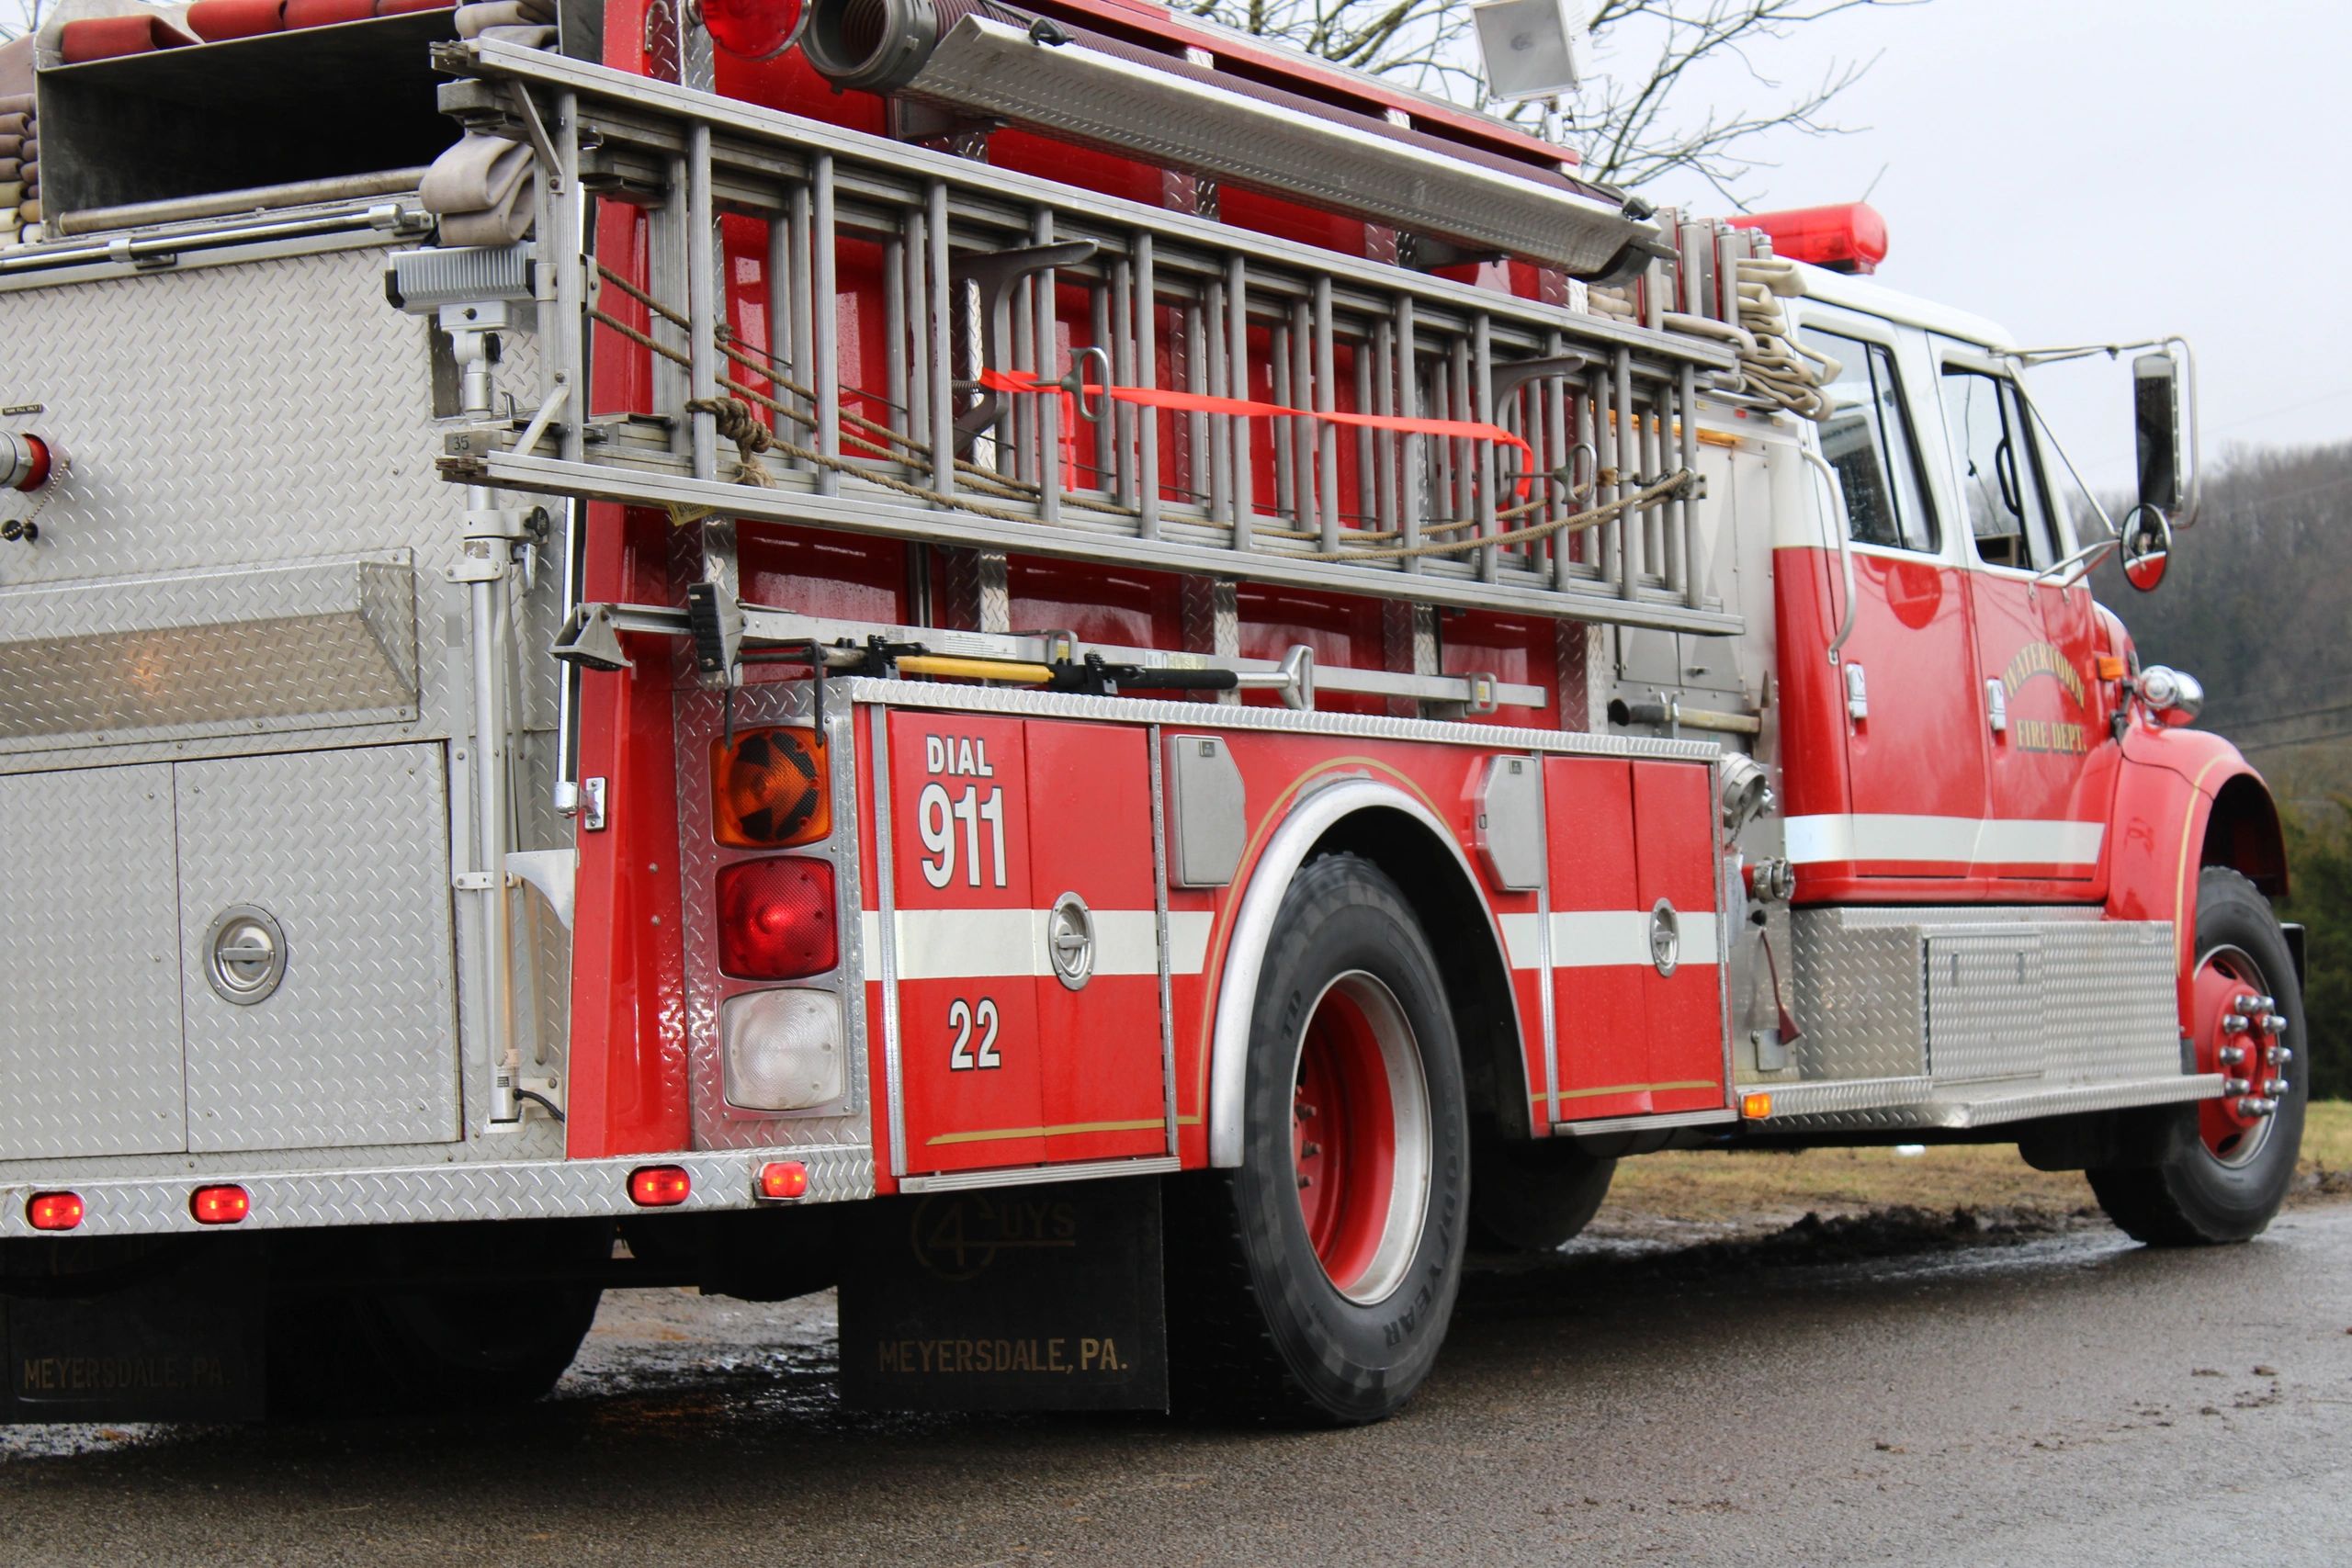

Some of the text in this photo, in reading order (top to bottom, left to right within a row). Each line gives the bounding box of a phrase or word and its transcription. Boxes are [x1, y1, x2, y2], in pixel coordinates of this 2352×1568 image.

[453, 434, 469, 450] 35
[2002, 642, 2085, 711] WATERTOWN
[926, 734, 993, 778] DIAL
[2016, 720, 2087, 755] FIRE DEPT.
[919, 781, 1007, 888] 911
[948, 996, 1001, 1072] 22
[877, 1337, 1128, 1374] MEYERSDALE, PA.
